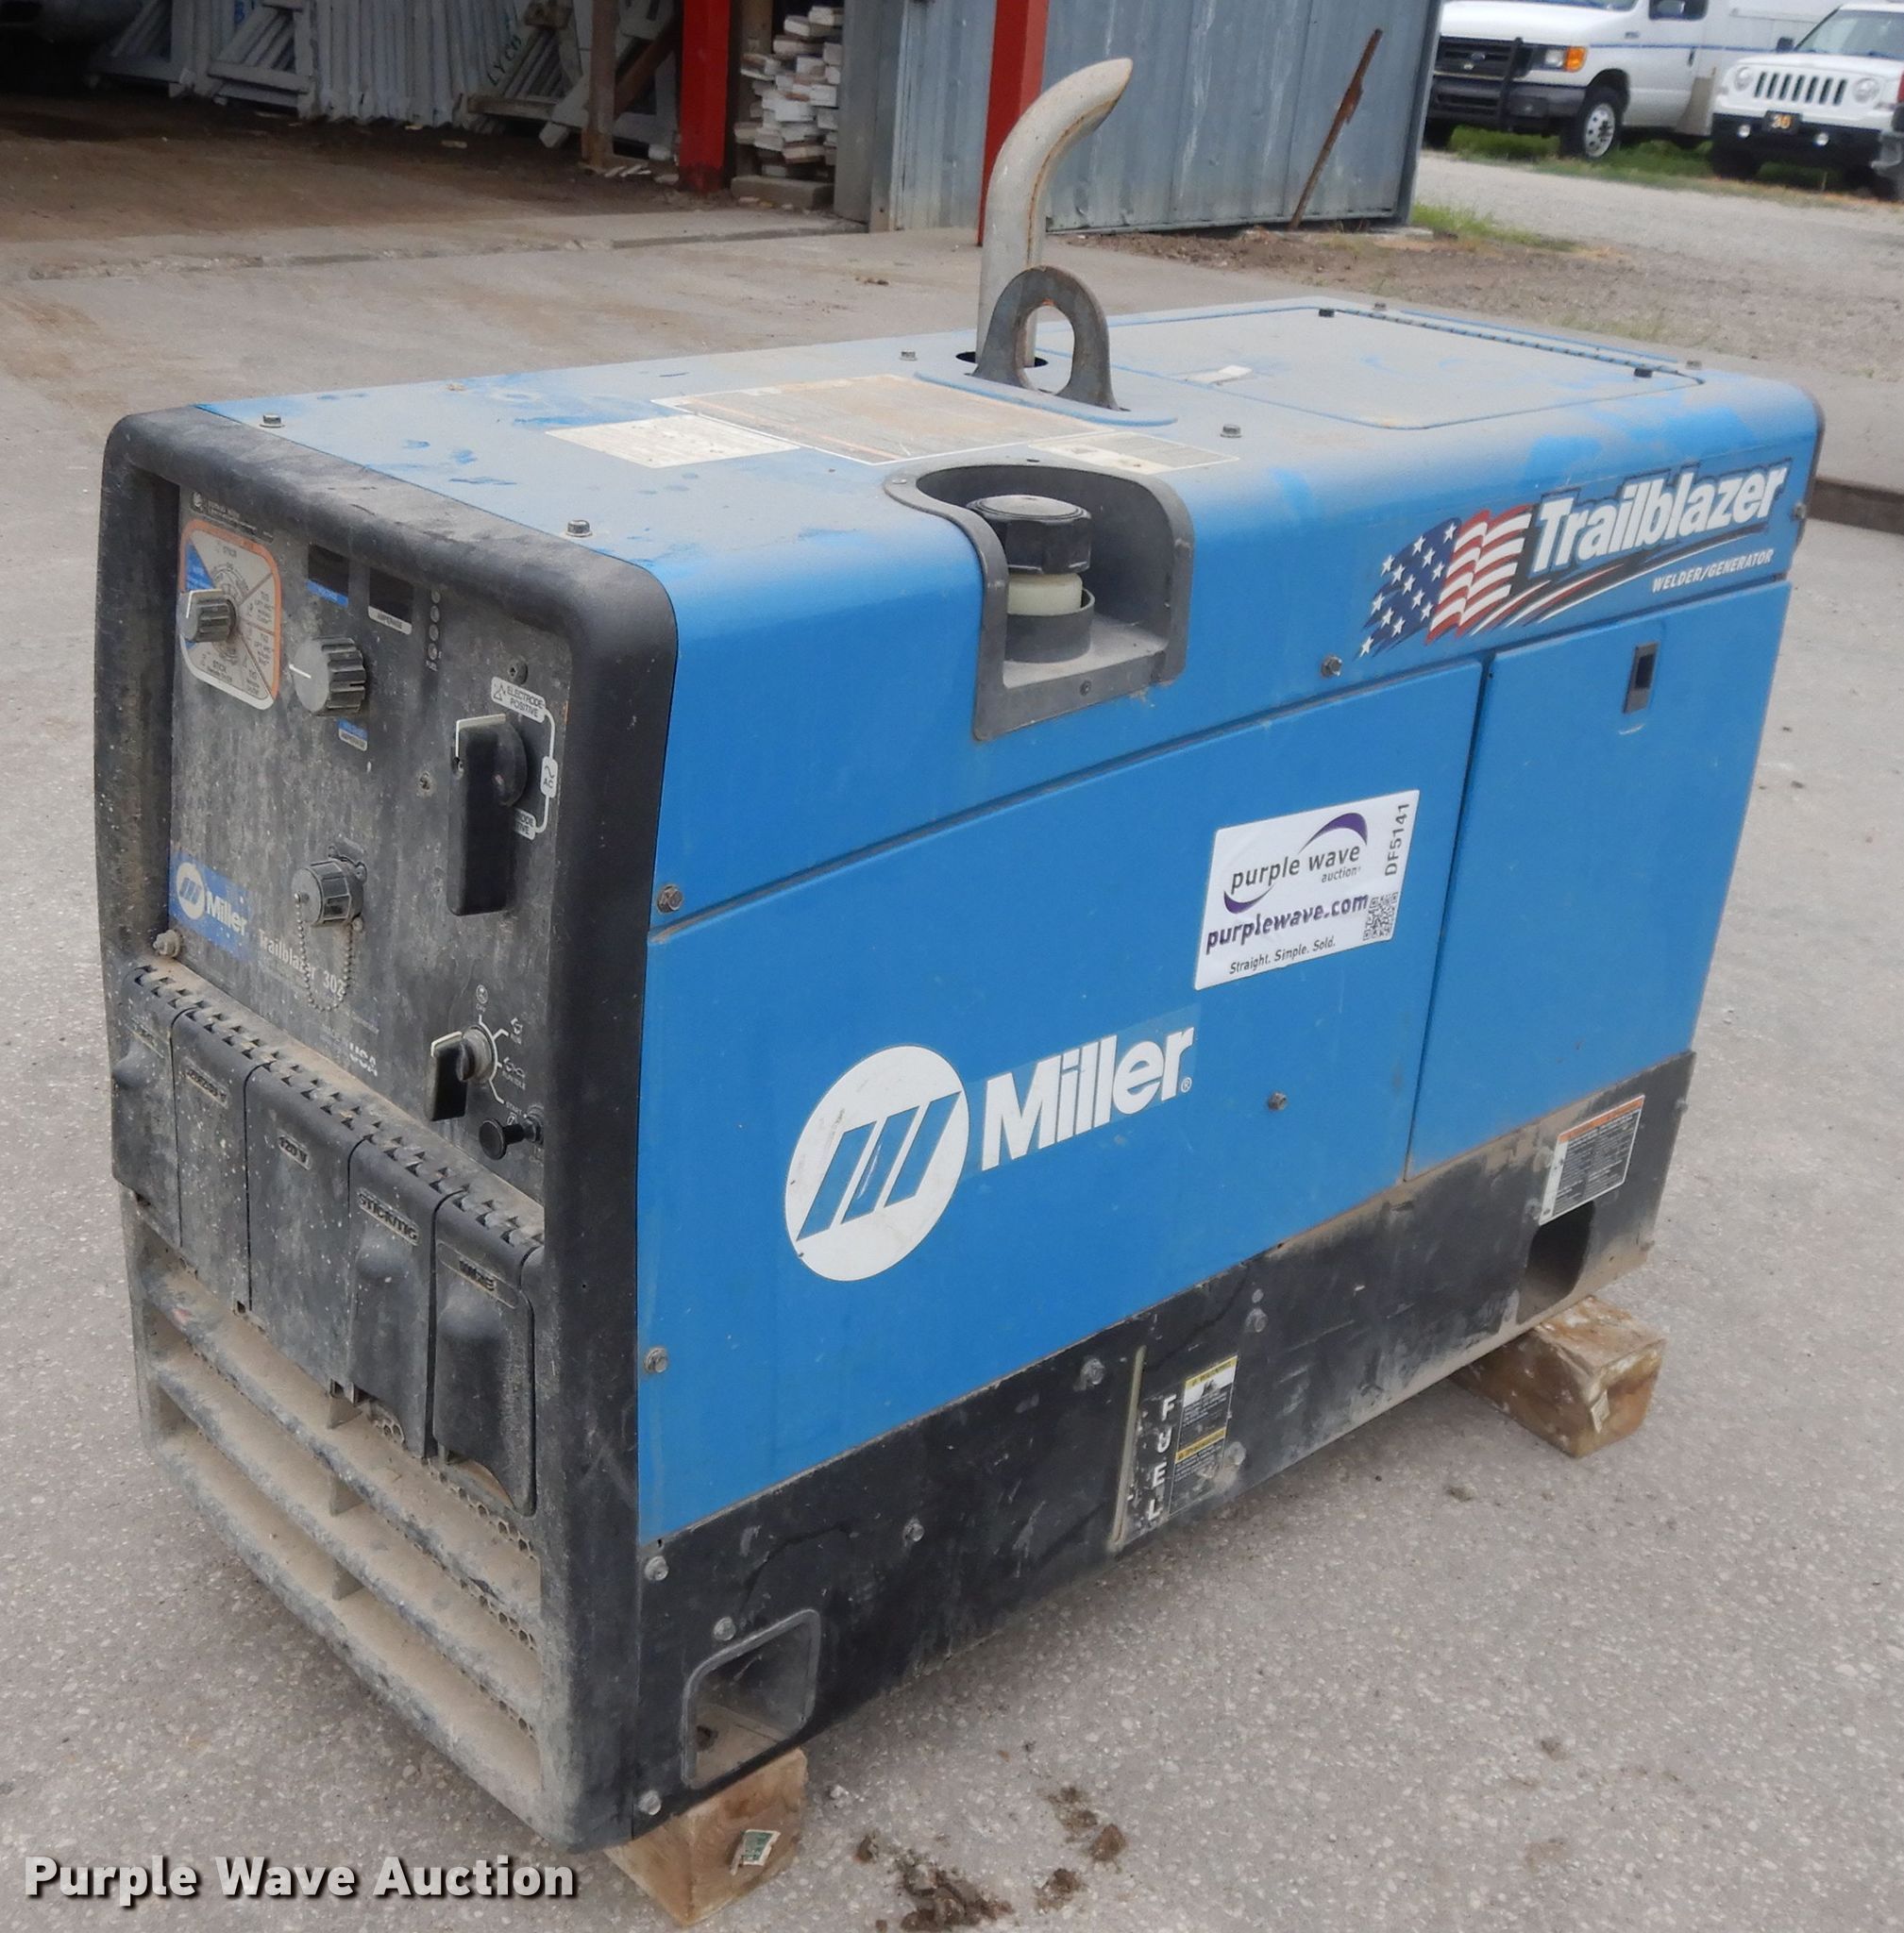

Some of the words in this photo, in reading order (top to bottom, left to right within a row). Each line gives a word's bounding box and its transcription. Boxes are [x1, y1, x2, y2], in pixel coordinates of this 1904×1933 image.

[1532, 466, 1788, 573] Trailblazer
[1652, 548, 1774, 594] WELDER/GENERATOR
[507, 685, 544, 710] ELECTRODE
[510, 698, 539, 718] POSITIVE
[1384, 803, 1410, 877] DF5141
[1231, 855, 1300, 895] purple
[1308, 845, 1360, 872] wave
[1321, 867, 1357, 883] auction
[206, 890, 248, 936] Miller
[1205, 894, 1369, 955] purplewave.com
[1229, 953, 1272, 975] Straight.
[1274, 944, 1309, 963] Simple.
[1312, 935, 1336, 953] Sold.
[981, 1027, 1195, 1172] Miller
